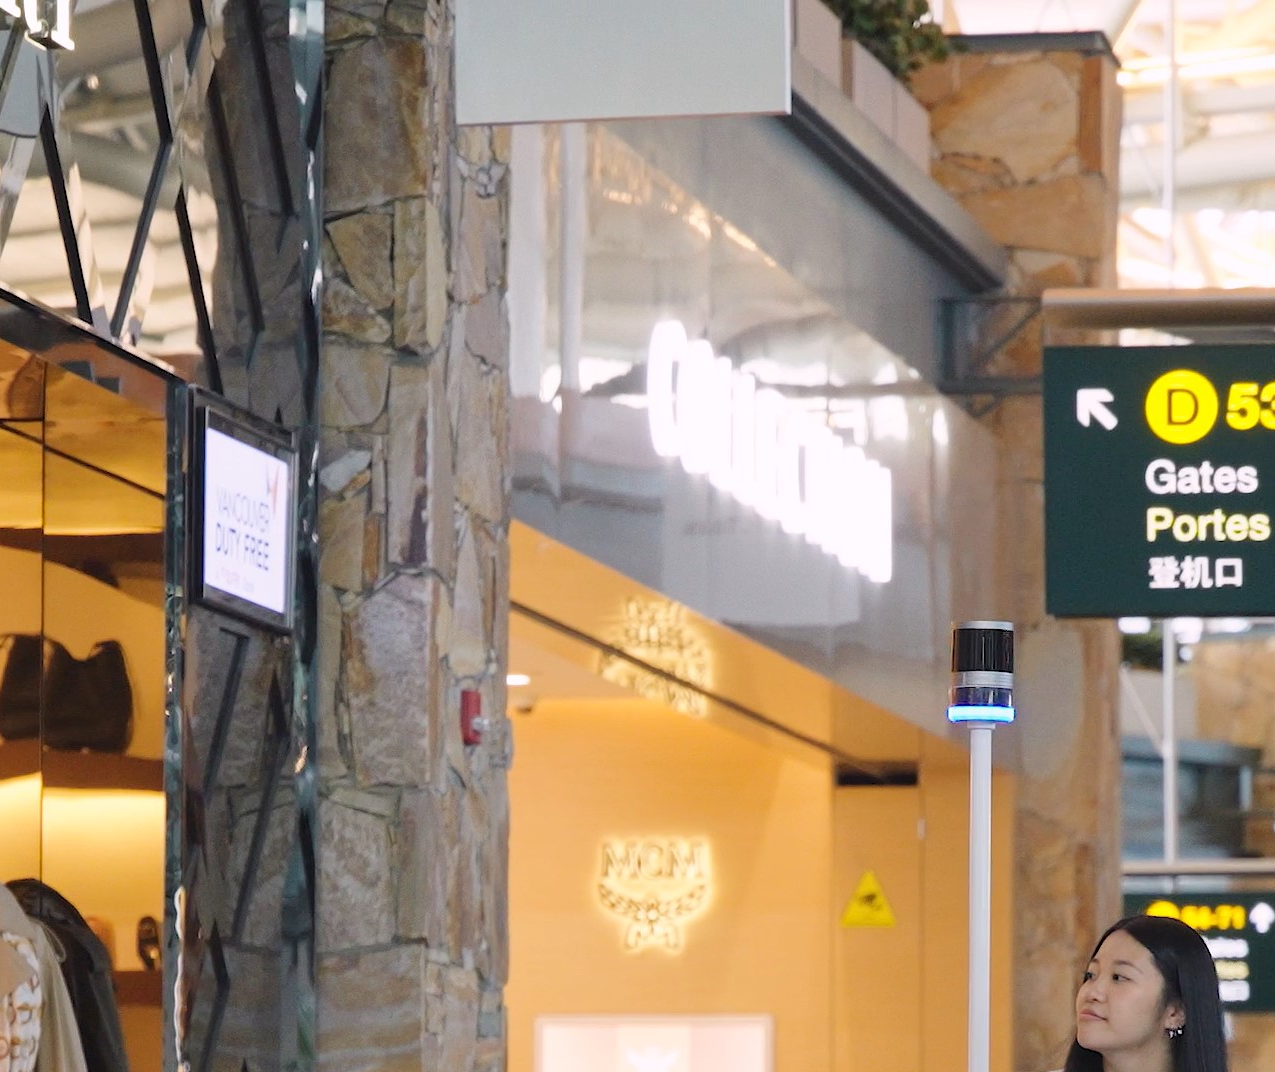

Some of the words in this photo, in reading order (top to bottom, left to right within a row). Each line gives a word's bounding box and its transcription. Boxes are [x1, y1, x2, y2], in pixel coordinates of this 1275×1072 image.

[1167, 388, 1199, 425] D
[1145, 459, 1259, 494] Gates
[1146, 507, 1272, 542] Portes
[215, 521, 241, 560] DUTY
[244, 533, 270, 573] FREE
[1148, 556, 1243, 589] 登机口
[601, 841, 705, 880] MCM
